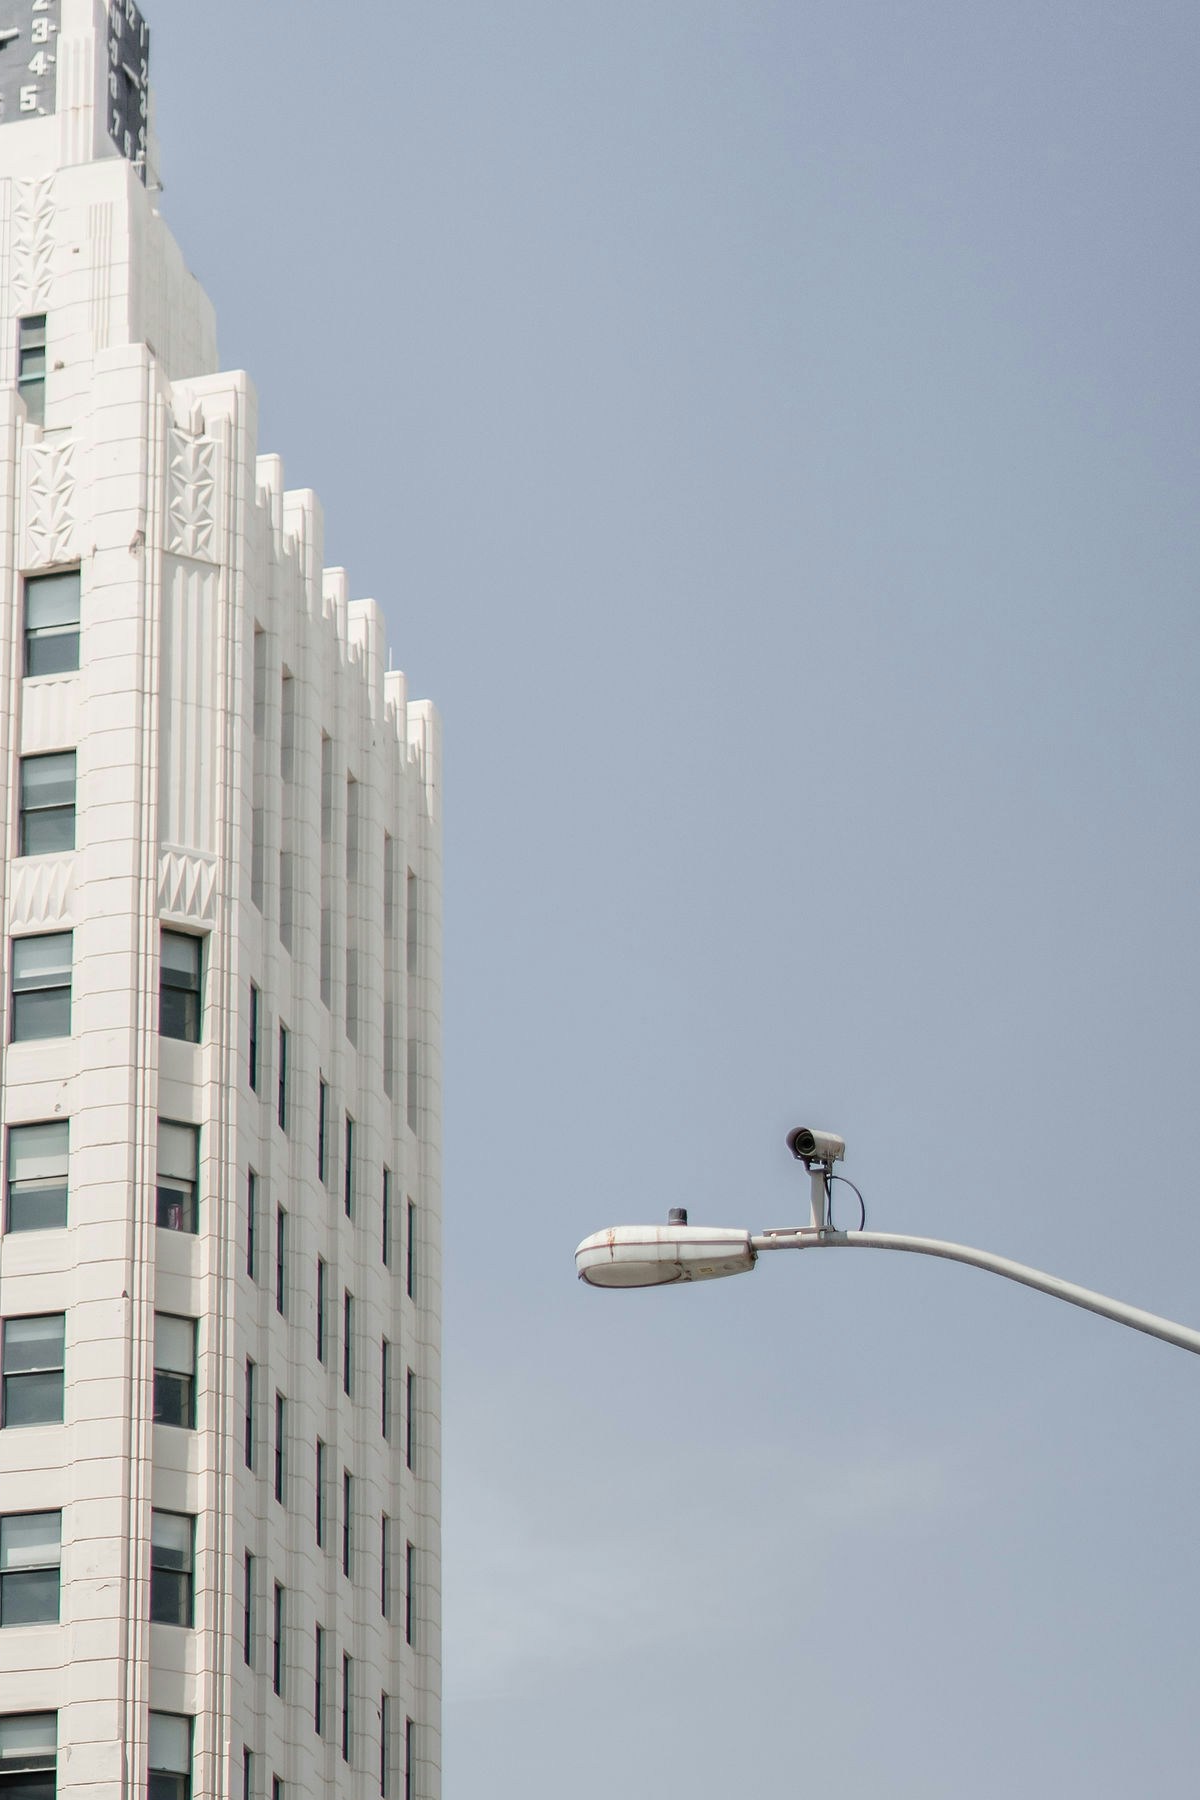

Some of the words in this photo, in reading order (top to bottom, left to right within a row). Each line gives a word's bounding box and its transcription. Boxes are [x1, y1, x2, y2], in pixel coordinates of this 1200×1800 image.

[31, 17, 49, 43] 3
[28, 51, 48, 76] 4
[19, 85, 38, 111] 5
